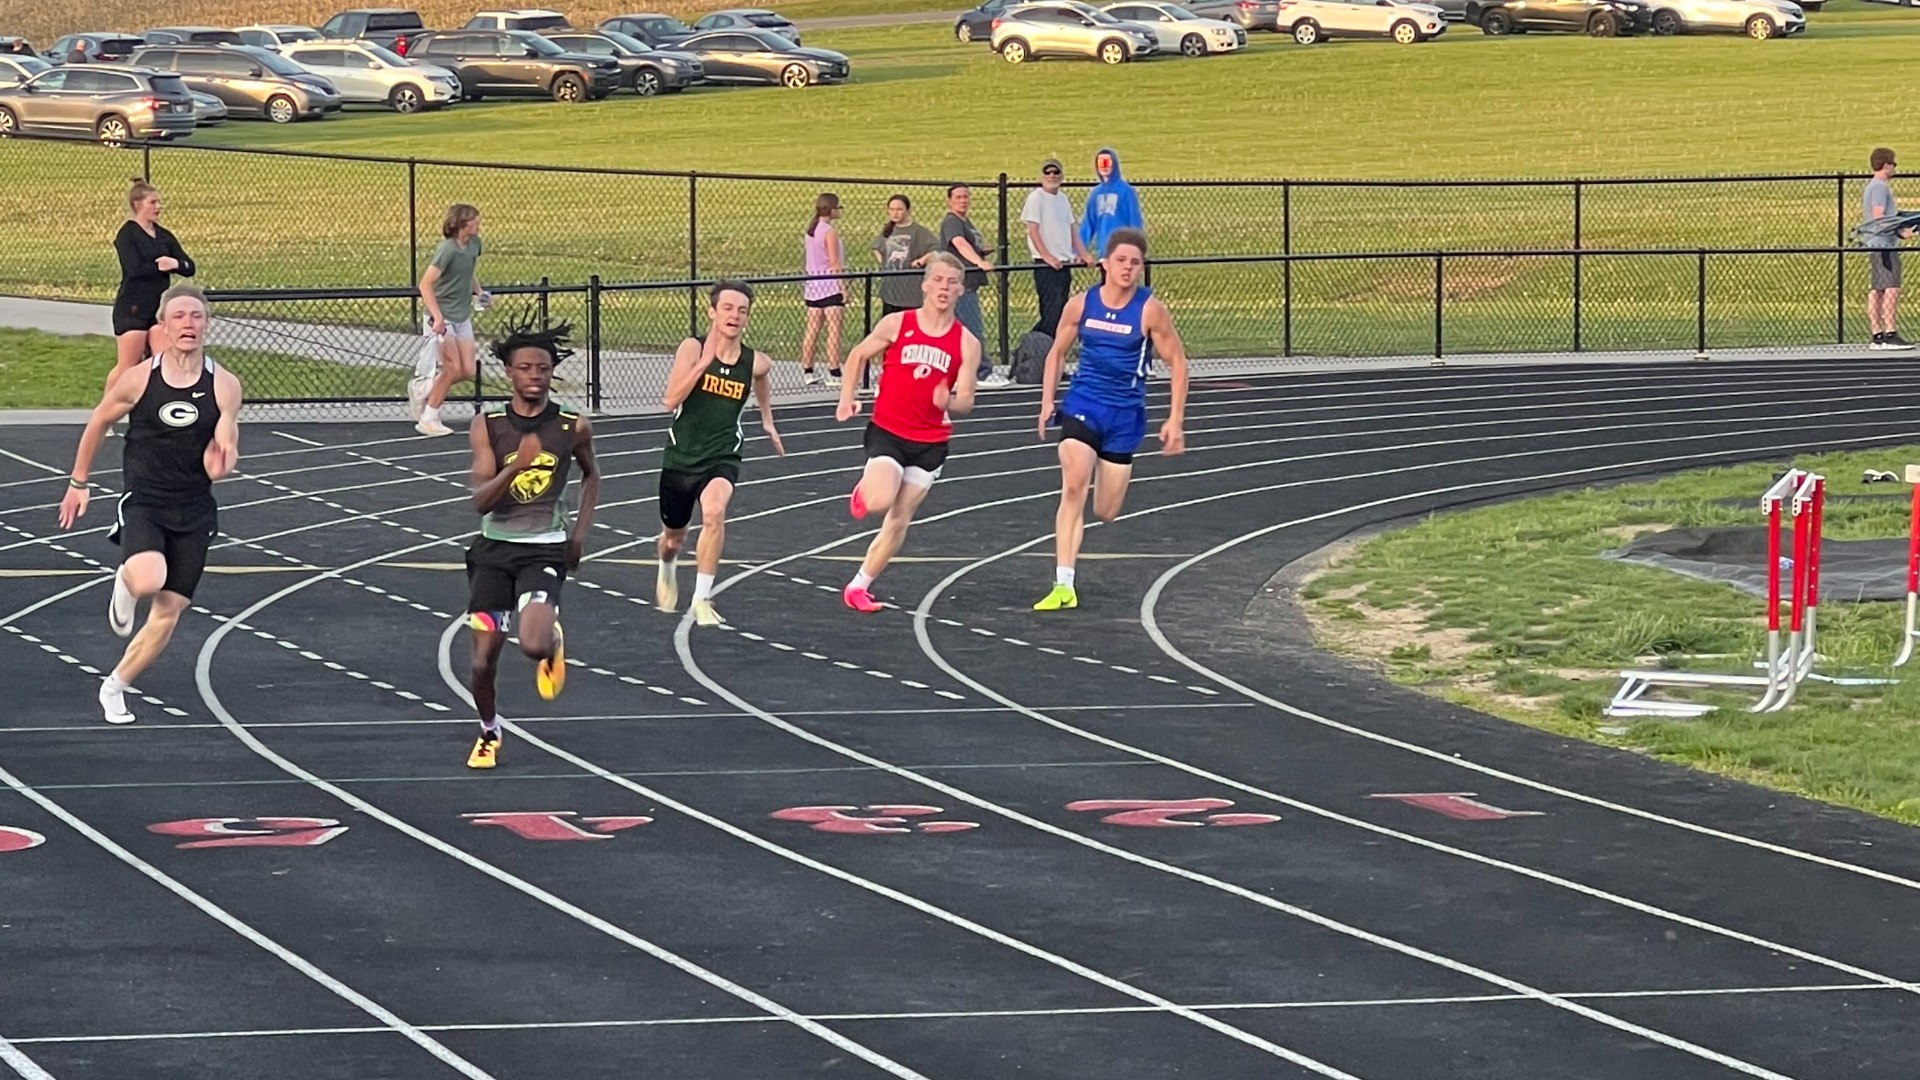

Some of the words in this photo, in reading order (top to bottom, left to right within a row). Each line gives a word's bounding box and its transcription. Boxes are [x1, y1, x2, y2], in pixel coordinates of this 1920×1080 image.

[901, 344, 952, 374] CEDARVILLE
[702, 373, 745, 400] IRISH
[159, 401, 199, 427] G
[770, 804, 981, 834] 3
[1066, 797, 1282, 828] 2
[1365, 792, 1547, 821] 1
[146, 817, 349, 850] 5
[458, 811, 654, 841] 4
